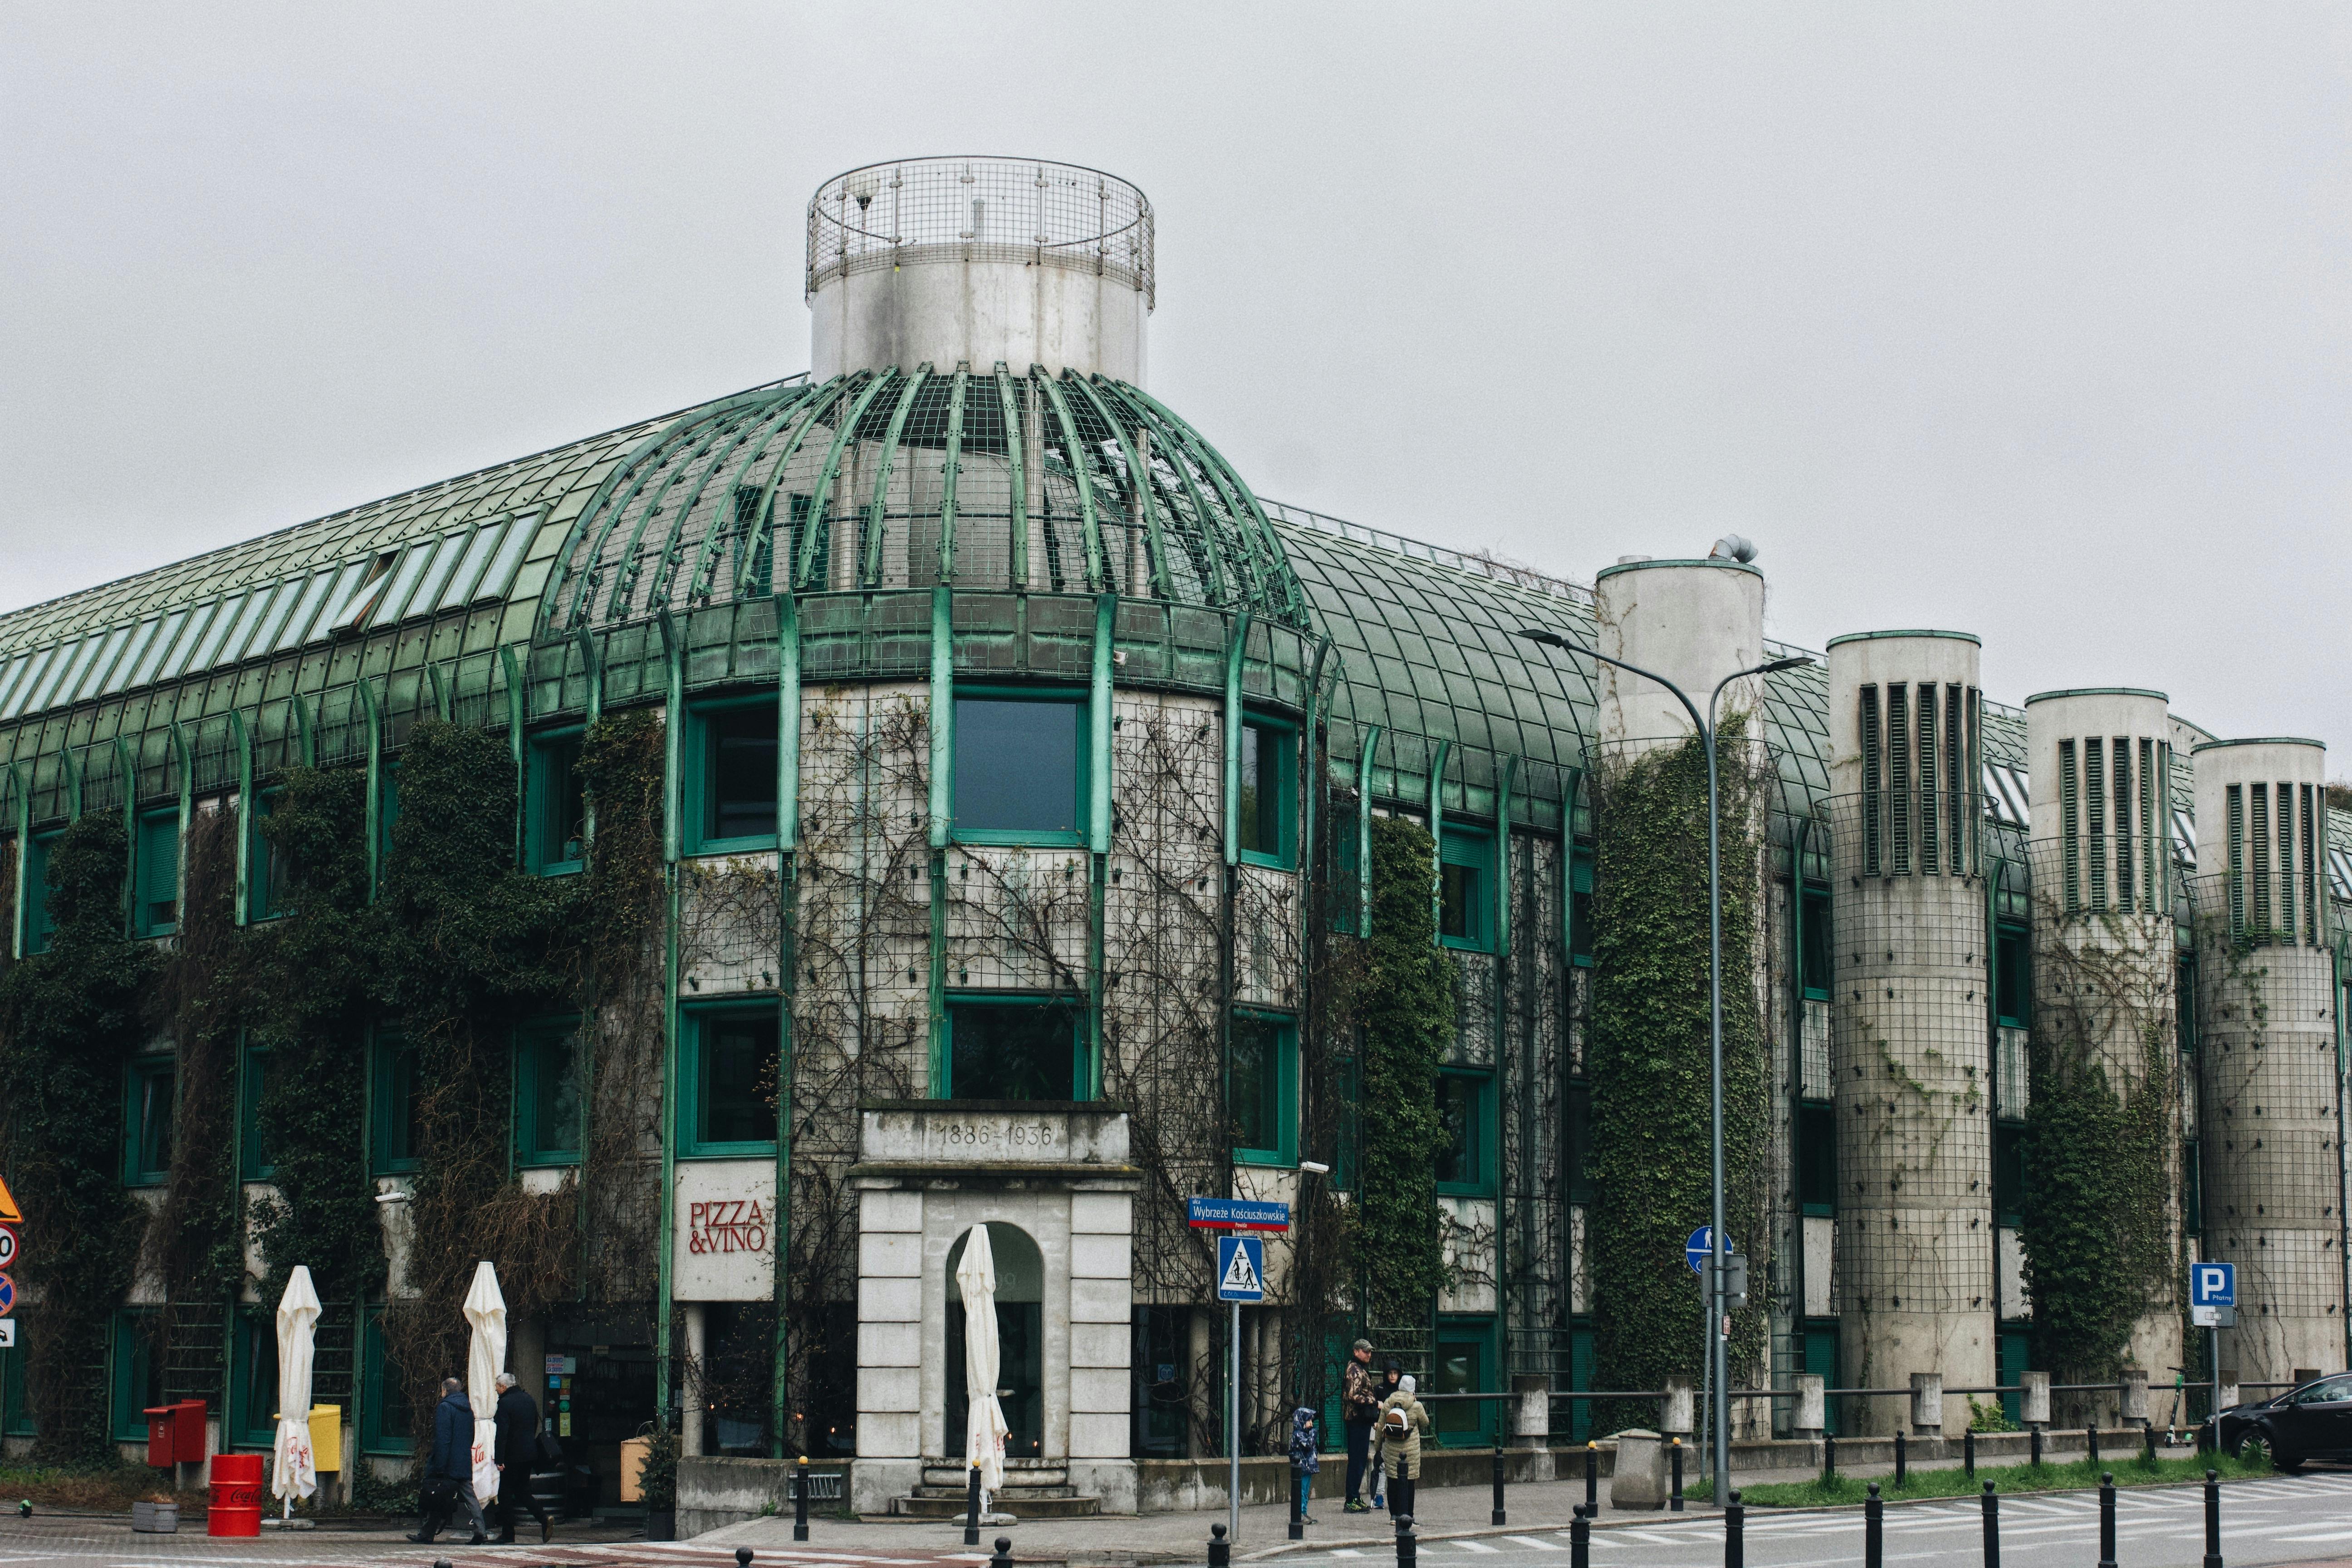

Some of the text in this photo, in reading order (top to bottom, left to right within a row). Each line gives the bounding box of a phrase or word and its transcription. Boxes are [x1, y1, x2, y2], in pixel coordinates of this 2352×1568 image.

[690, 1199, 765, 1227] PIZZA
[1193, 1205, 1285, 1221] Wybrzeże Kościuszkowskie
[689, 1225, 765, 1254] &VINO
[2201, 1268, 2225, 1300] P
